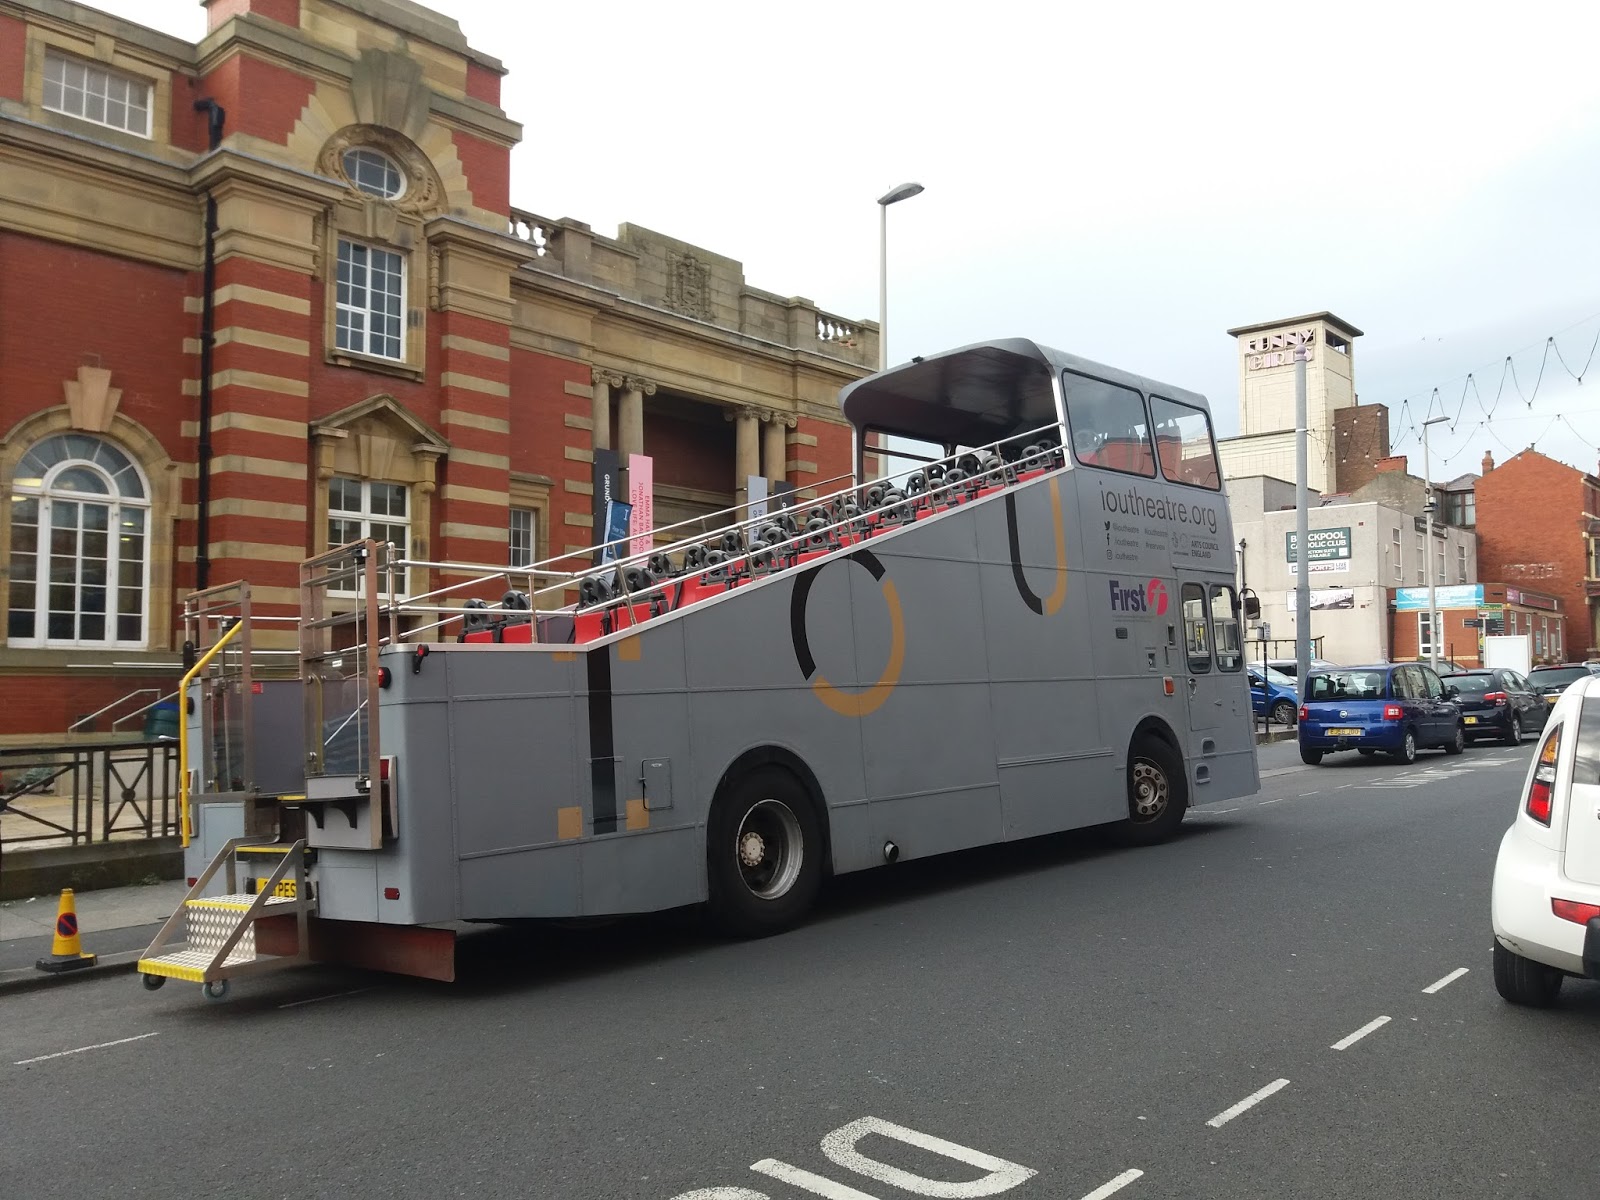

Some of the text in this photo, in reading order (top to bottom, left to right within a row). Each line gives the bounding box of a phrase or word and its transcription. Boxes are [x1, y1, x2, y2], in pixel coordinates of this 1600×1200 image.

[1244, 328, 1316, 354] FUNNY
[1099, 480, 1218, 534] ioutheatre.org
[1291, 532, 1346, 543] BCKPOOL
[1202, 542, 1219, 551] COUNCIL
[1291, 539, 1346, 549] COLIC CLUB
[1191, 549, 1212, 559] ENGLAND
[1108, 580, 1147, 612] First
